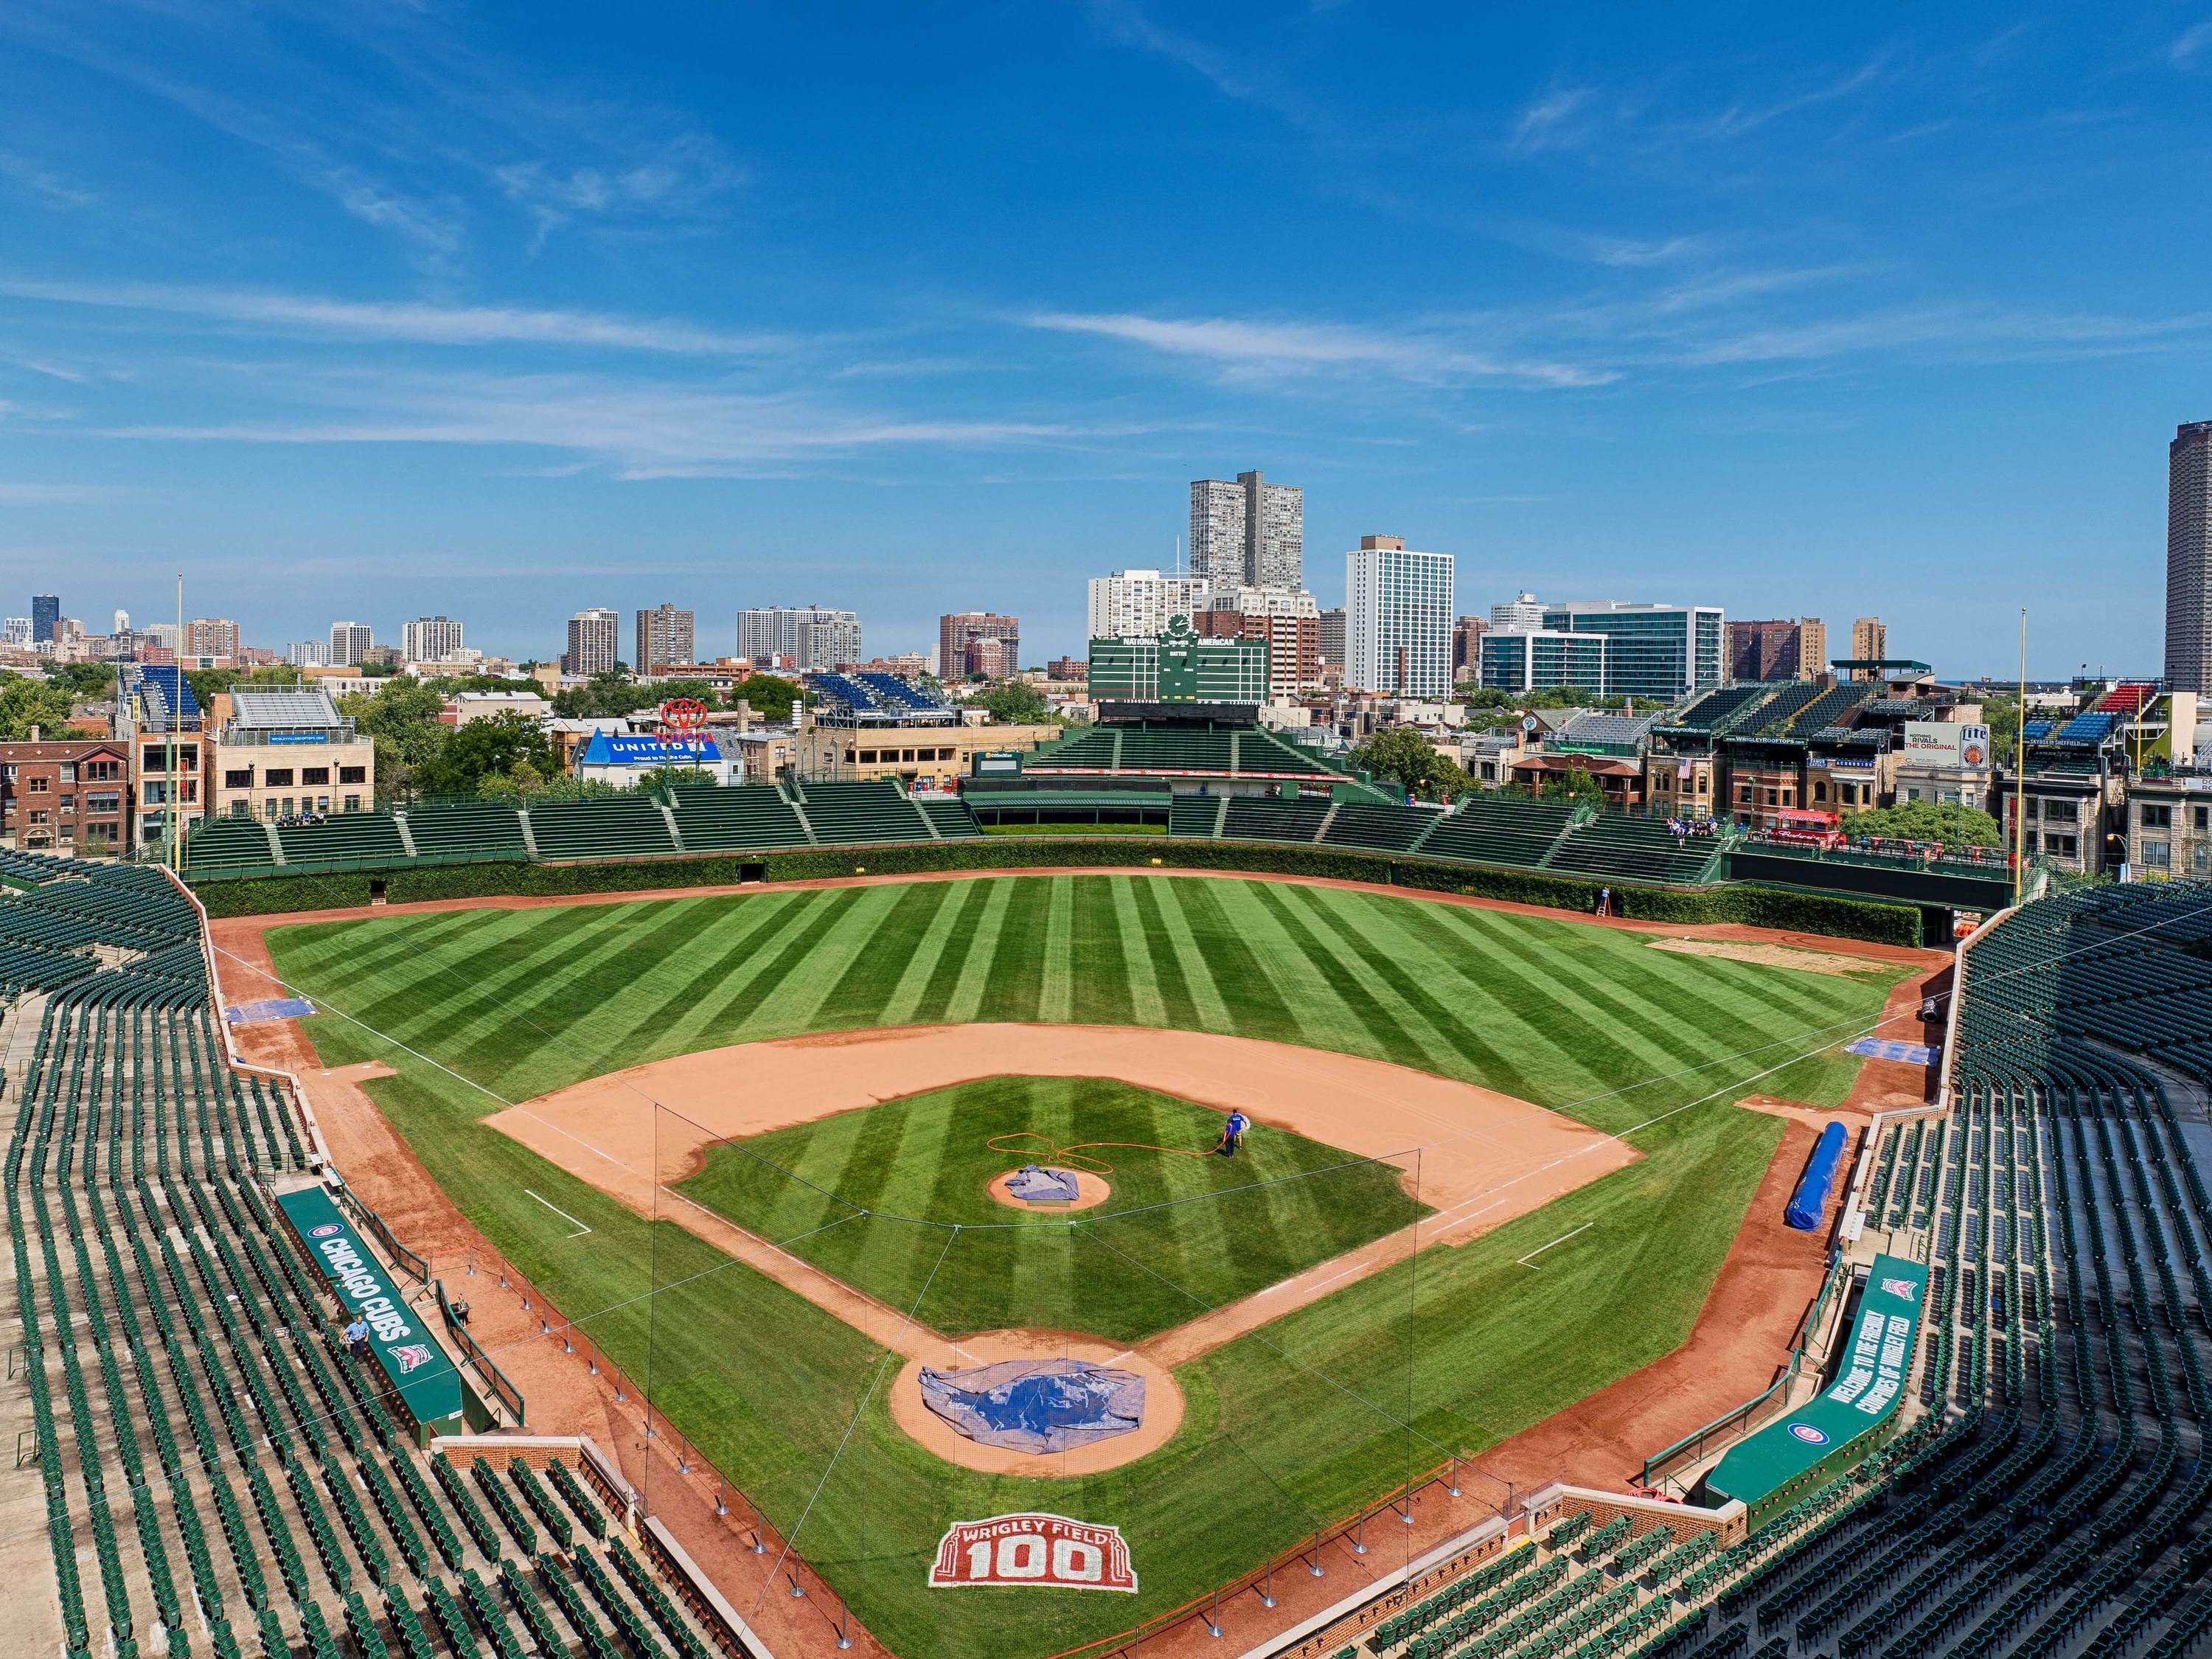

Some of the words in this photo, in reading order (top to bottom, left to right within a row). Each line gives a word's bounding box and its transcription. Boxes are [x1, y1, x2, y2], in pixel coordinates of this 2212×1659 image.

[1123, 638, 1161, 646] NATIONAL
[653, 732, 715, 744] TOYOTA
[1652, 726, 1711, 734] 3639wrigleyrooftop.com
[1962, 727, 1986, 741] Lite
[612, 743, 684, 751] UNITED
[1778, 812, 1826, 823] Budweiser
[319, 1238, 381, 1298] CHICAGO
[360, 1297, 411, 1342] CUBS
[1859, 1309, 1885, 1343] FRIENDLY
[1886, 1315, 1910, 1338] FIELD
[1855, 1340, 1879, 1357] THE
[1879, 1333, 1906, 1368] WRIGLEY
[1853, 1354, 1875, 1368] TO
[1878, 1365, 1901, 1380] OF
[1827, 1366, 1874, 1404] WELCOME
[1855, 1377, 1899, 1414] CONFINES
[962, 1520, 1046, 1543] WRIGLEY
[1052, 1522, 1109, 1545] FIELD
[966, 1534, 1103, 1582] 100
